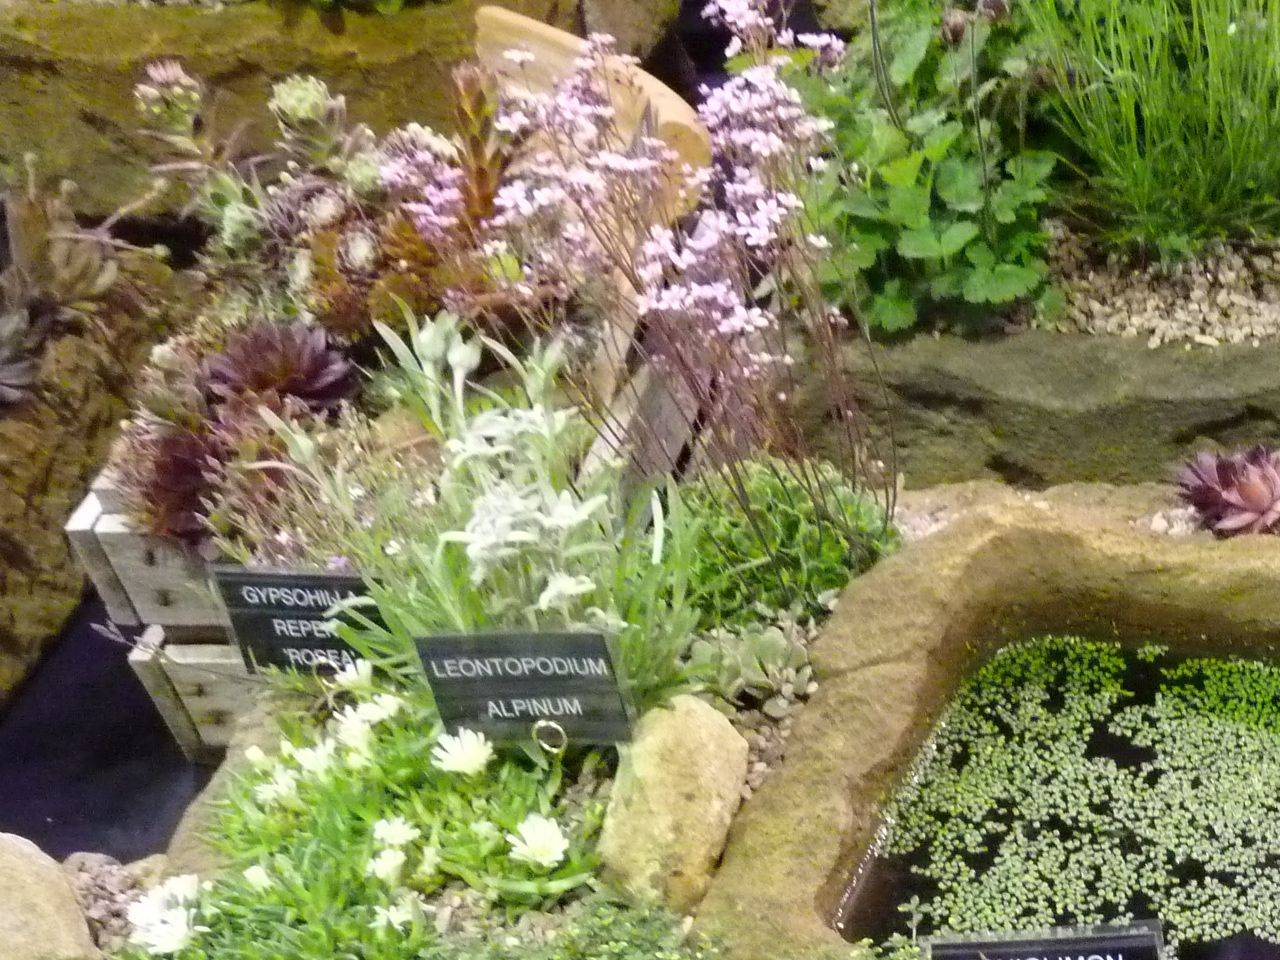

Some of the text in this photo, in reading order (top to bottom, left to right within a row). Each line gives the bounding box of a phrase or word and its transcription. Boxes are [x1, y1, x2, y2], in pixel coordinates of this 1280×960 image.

[272, 619, 341, 638] REPE
[431, 655, 608, 679] LEONTOPODIUM
[487, 699, 582, 718] ALPINUM
